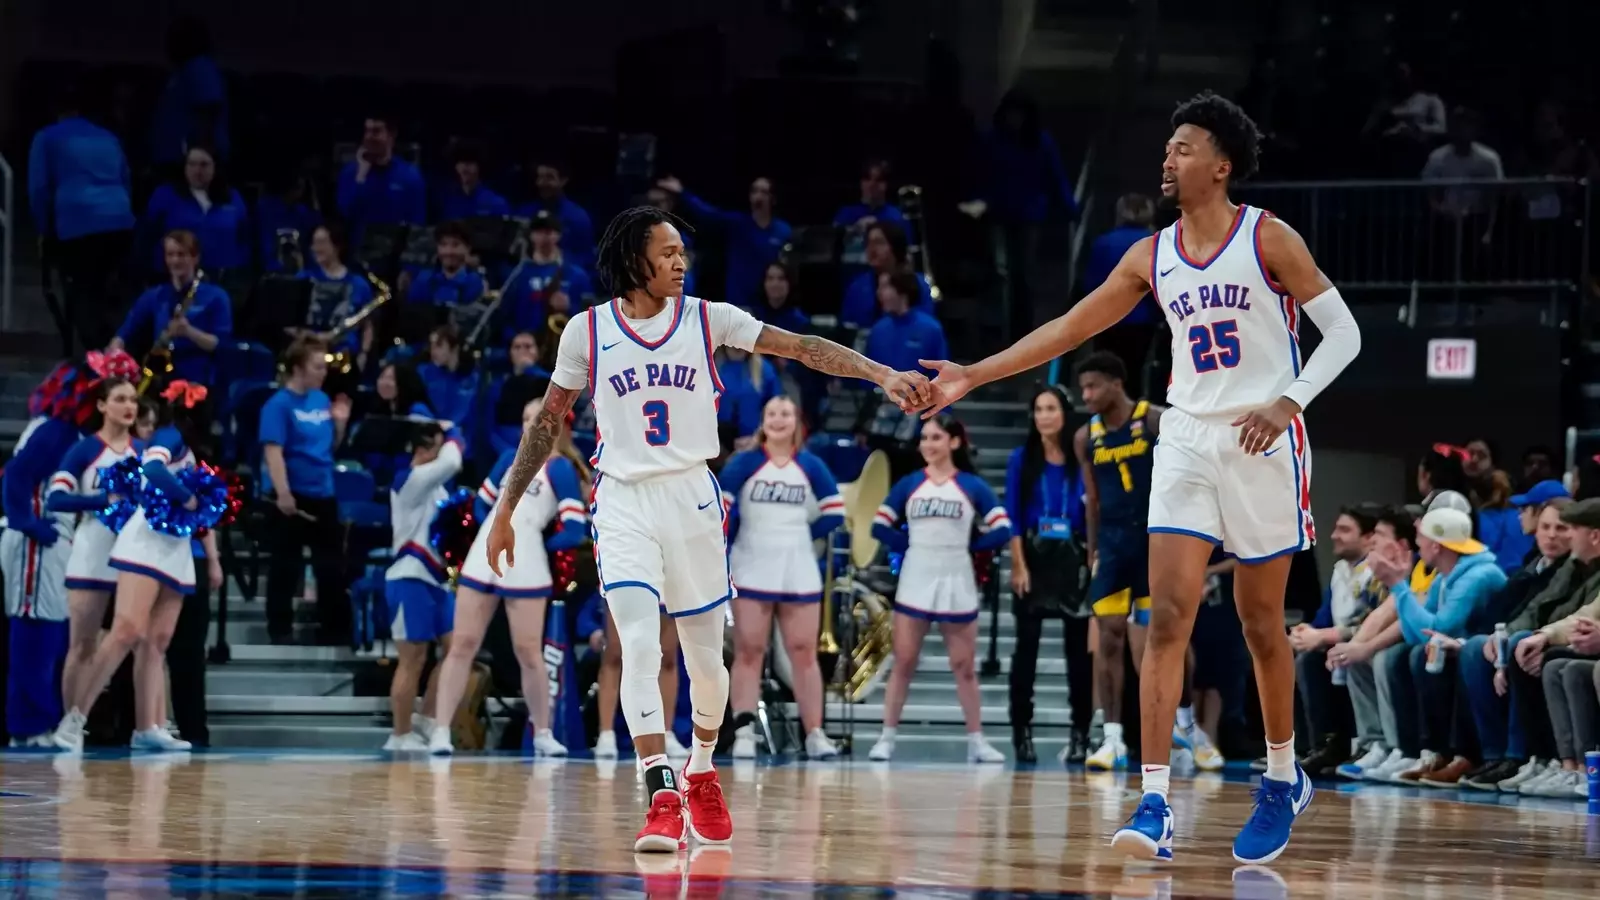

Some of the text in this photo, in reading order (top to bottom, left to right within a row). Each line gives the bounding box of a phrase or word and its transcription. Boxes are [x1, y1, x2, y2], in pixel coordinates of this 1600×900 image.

[1168, 283, 1251, 322] DE PAUL
[1188, 318, 1241, 374] 25
[1434, 345, 1467, 372] EXIT
[608, 363, 697, 398] DE PAUL
[642, 399, 671, 447] 3
[1118, 461, 1134, 492] 1
